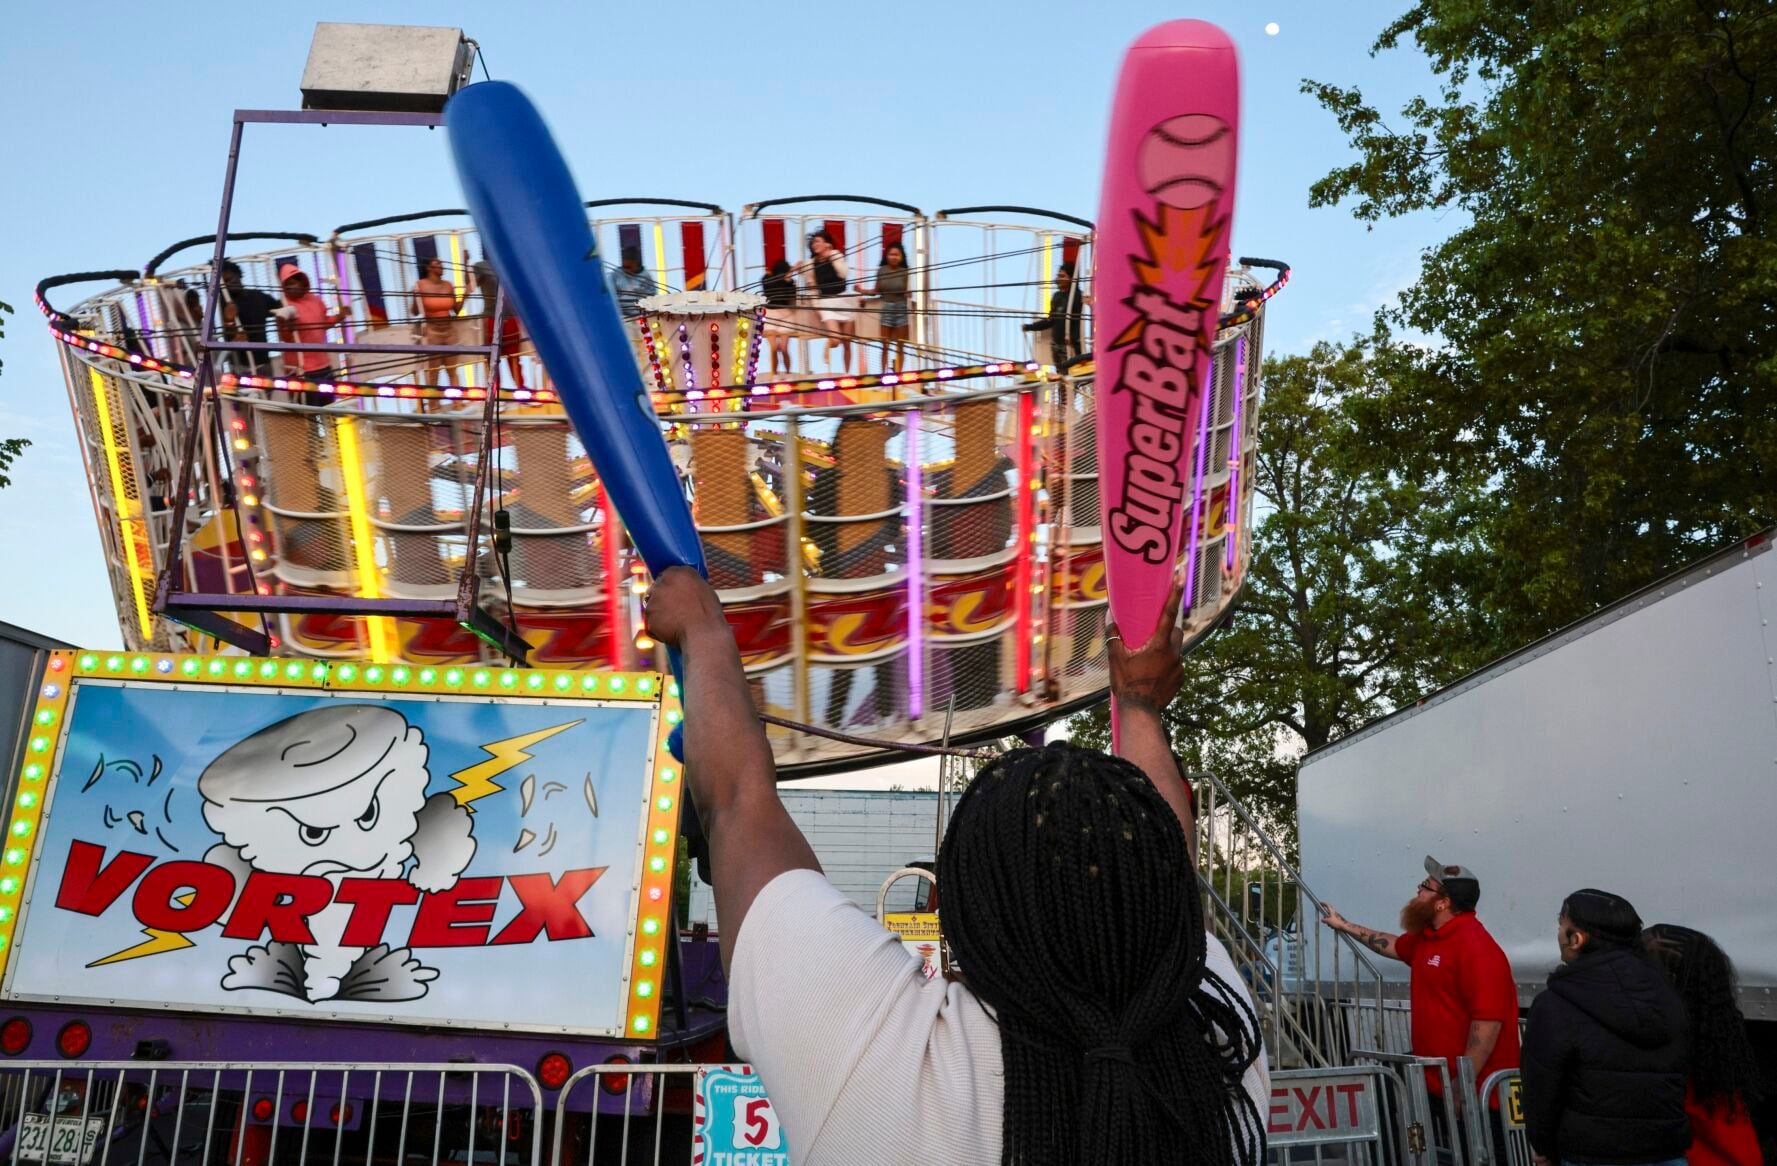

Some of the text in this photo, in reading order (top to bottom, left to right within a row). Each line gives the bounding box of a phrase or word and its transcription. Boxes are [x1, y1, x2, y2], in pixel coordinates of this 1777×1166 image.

[1109, 284, 1203, 564] SuperBat
[54, 838, 610, 948] VORTEX
[714, 1085, 738, 1094] THIS
[1267, 1083, 1365, 1133] EXIT
[744, 1099, 770, 1146] 5
[713, 1152, 789, 1166] TICKET
